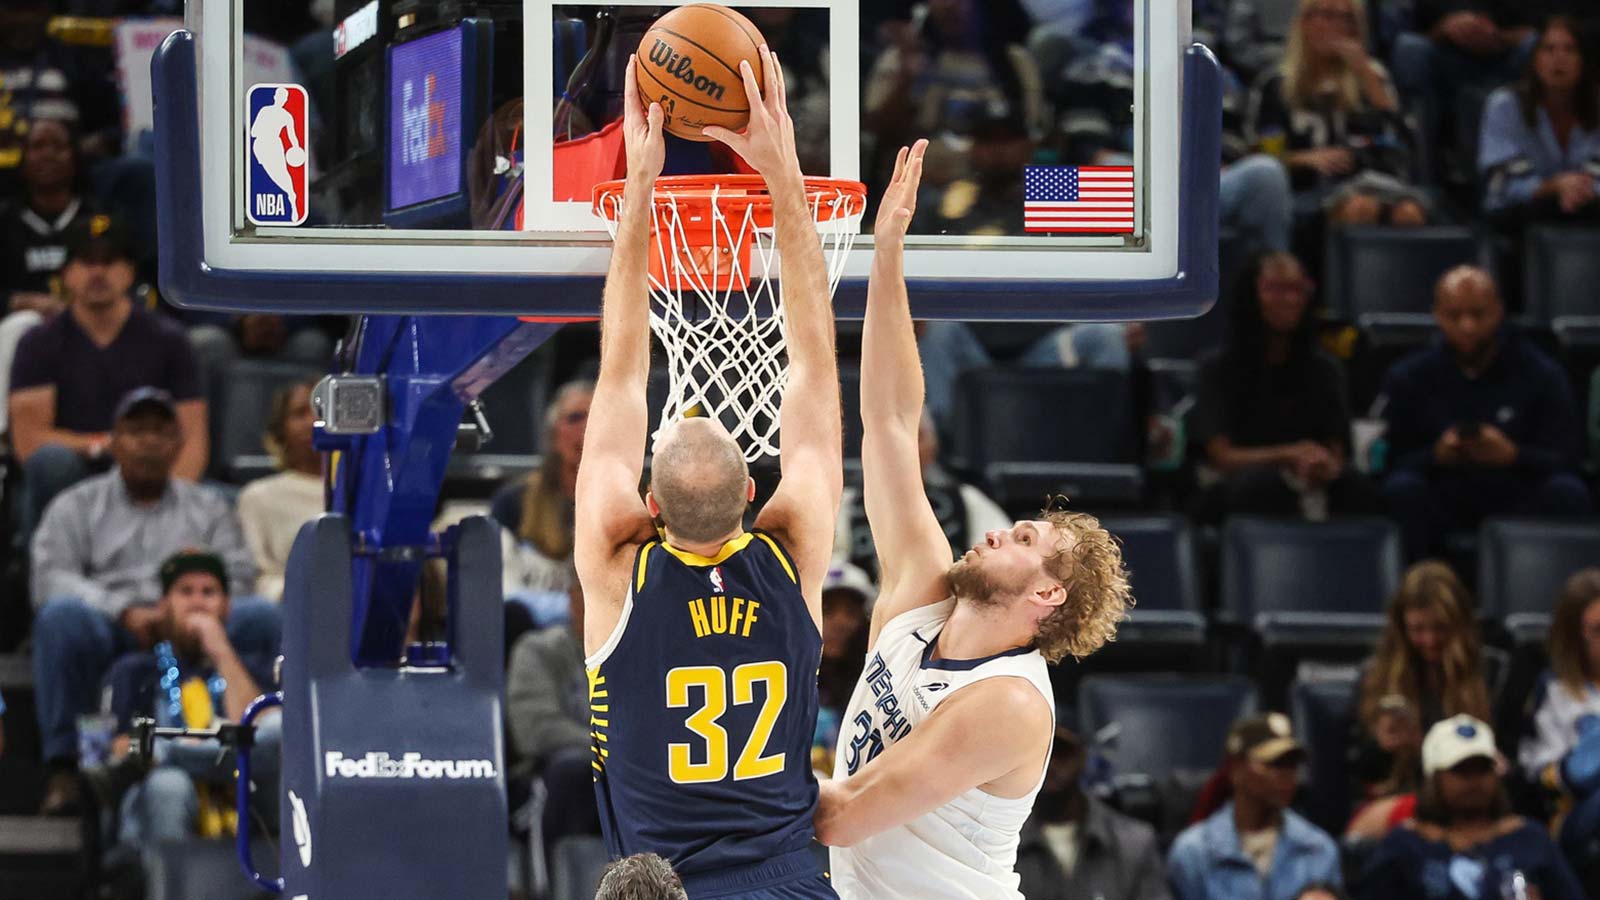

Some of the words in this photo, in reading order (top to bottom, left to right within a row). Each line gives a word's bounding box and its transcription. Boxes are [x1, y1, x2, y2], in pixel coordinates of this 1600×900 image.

[649, 38, 726, 100] Wilson
[256, 193, 285, 216] NBA
[688, 596, 760, 638] HUFF
[665, 661, 787, 784] 32
